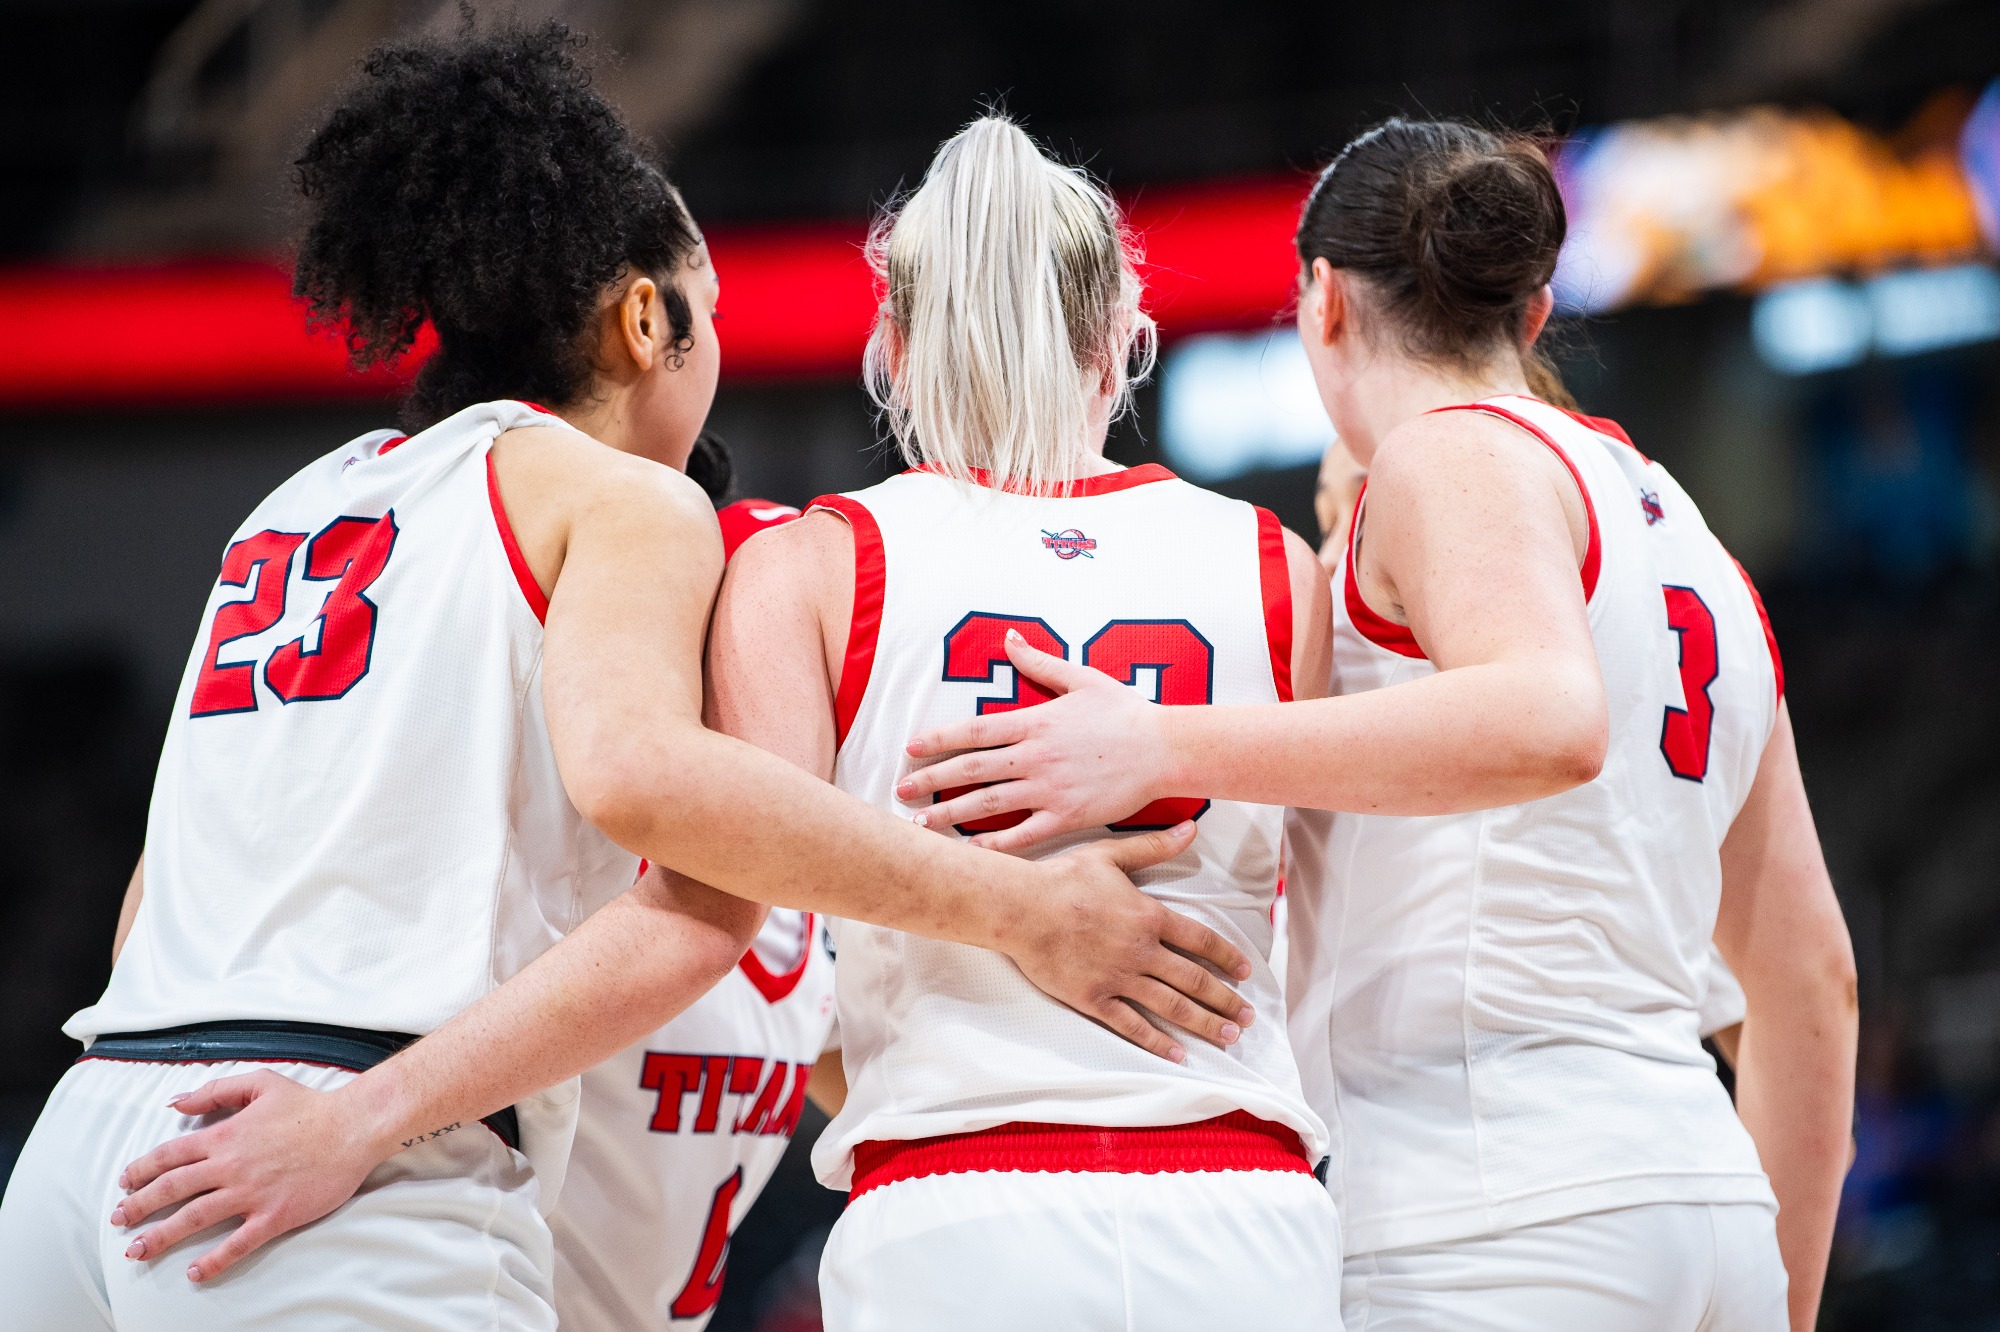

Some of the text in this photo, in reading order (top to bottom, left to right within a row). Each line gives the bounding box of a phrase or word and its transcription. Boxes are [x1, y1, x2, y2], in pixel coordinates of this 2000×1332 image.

[189, 507, 400, 719] 23
[1042, 537, 1097, 550] TITANS
[1660, 584, 1719, 784] 3
